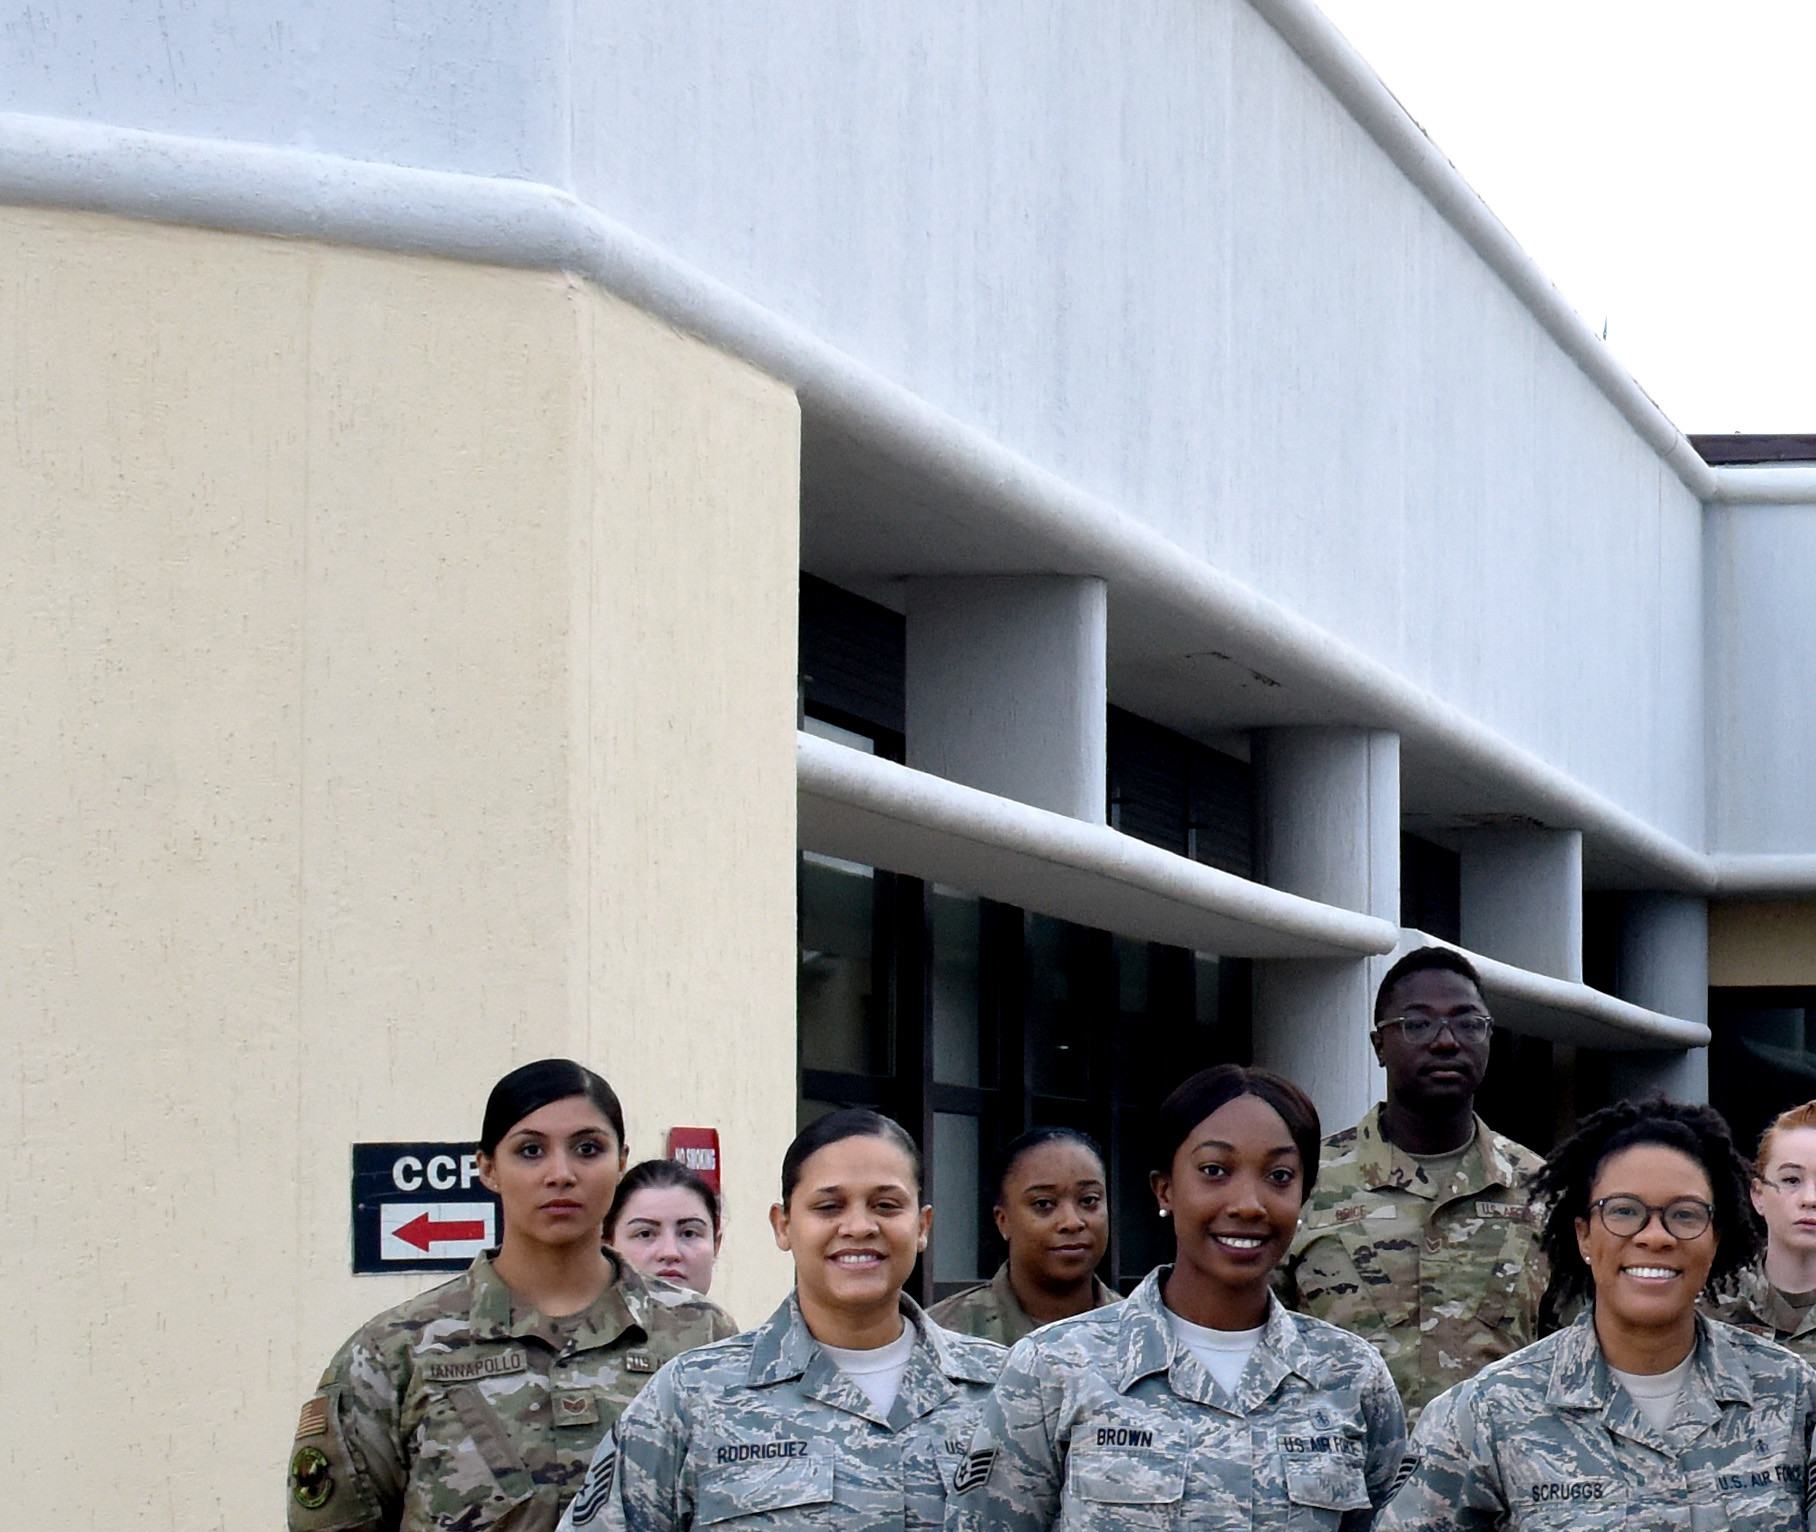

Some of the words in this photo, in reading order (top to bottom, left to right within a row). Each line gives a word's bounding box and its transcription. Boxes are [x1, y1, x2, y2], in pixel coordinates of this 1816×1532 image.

[430, 1353, 521, 1378] IANNAPOLLO
[1096, 1427, 1153, 1448] BROWN
[1310, 1436, 1331, 1453] AIR
[717, 1441, 809, 1464] RODRIGUEZ
[1532, 1481, 1604, 1501] SCRUGGS
[1718, 1475, 1747, 1491] U.S.
[1751, 1470, 1772, 1488] AIR
